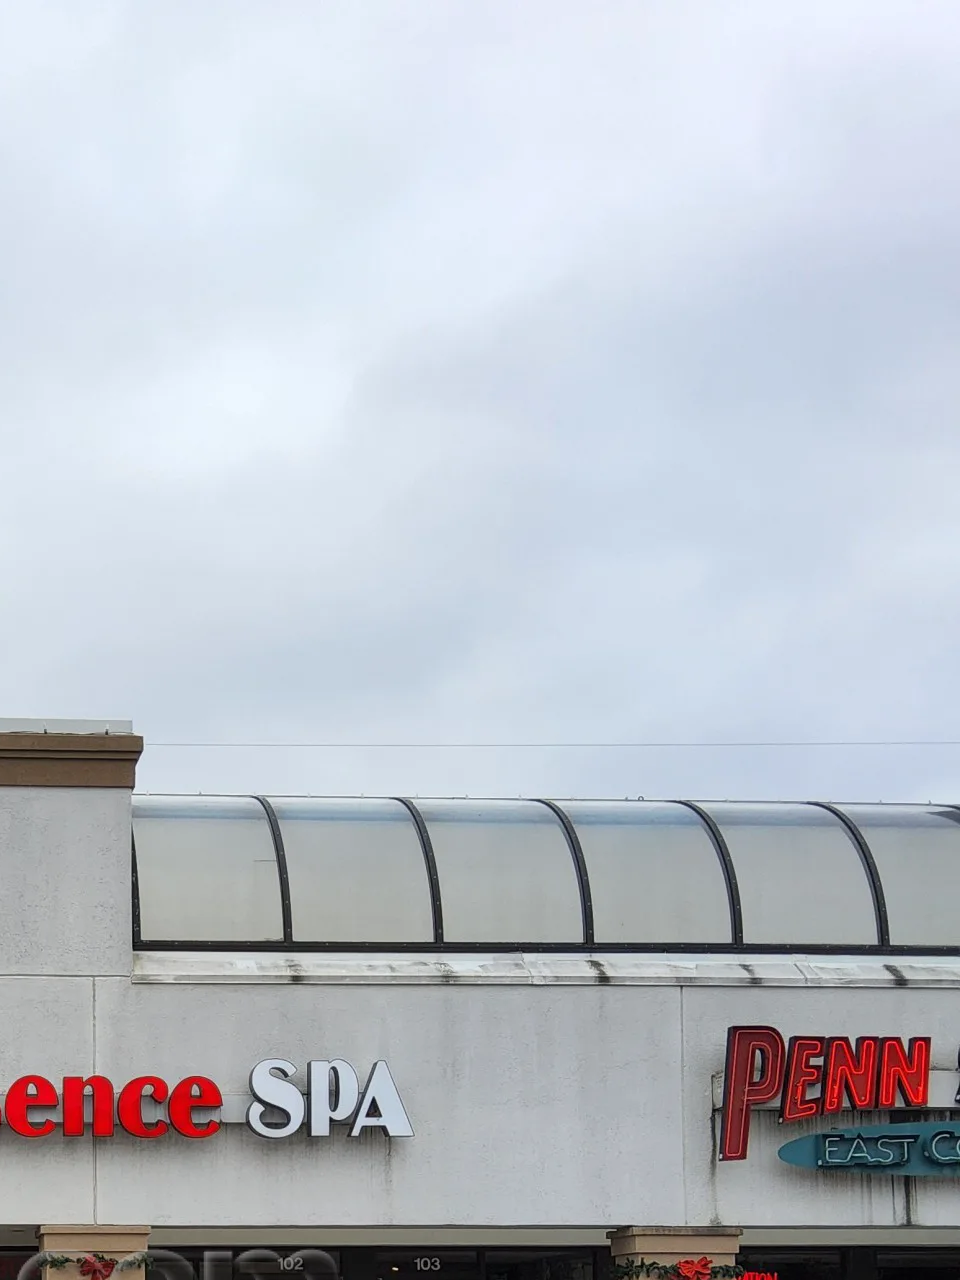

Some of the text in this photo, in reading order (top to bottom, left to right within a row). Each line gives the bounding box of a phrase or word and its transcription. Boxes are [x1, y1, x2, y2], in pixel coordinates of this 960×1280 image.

[246, 1057, 416, 1139] SPA
[719, 1025, 932, 1162] PENN
[819, 1132, 919, 1168] EAST
[277, 1257, 304, 1271] 102
[413, 1257, 441, 1271] 103
